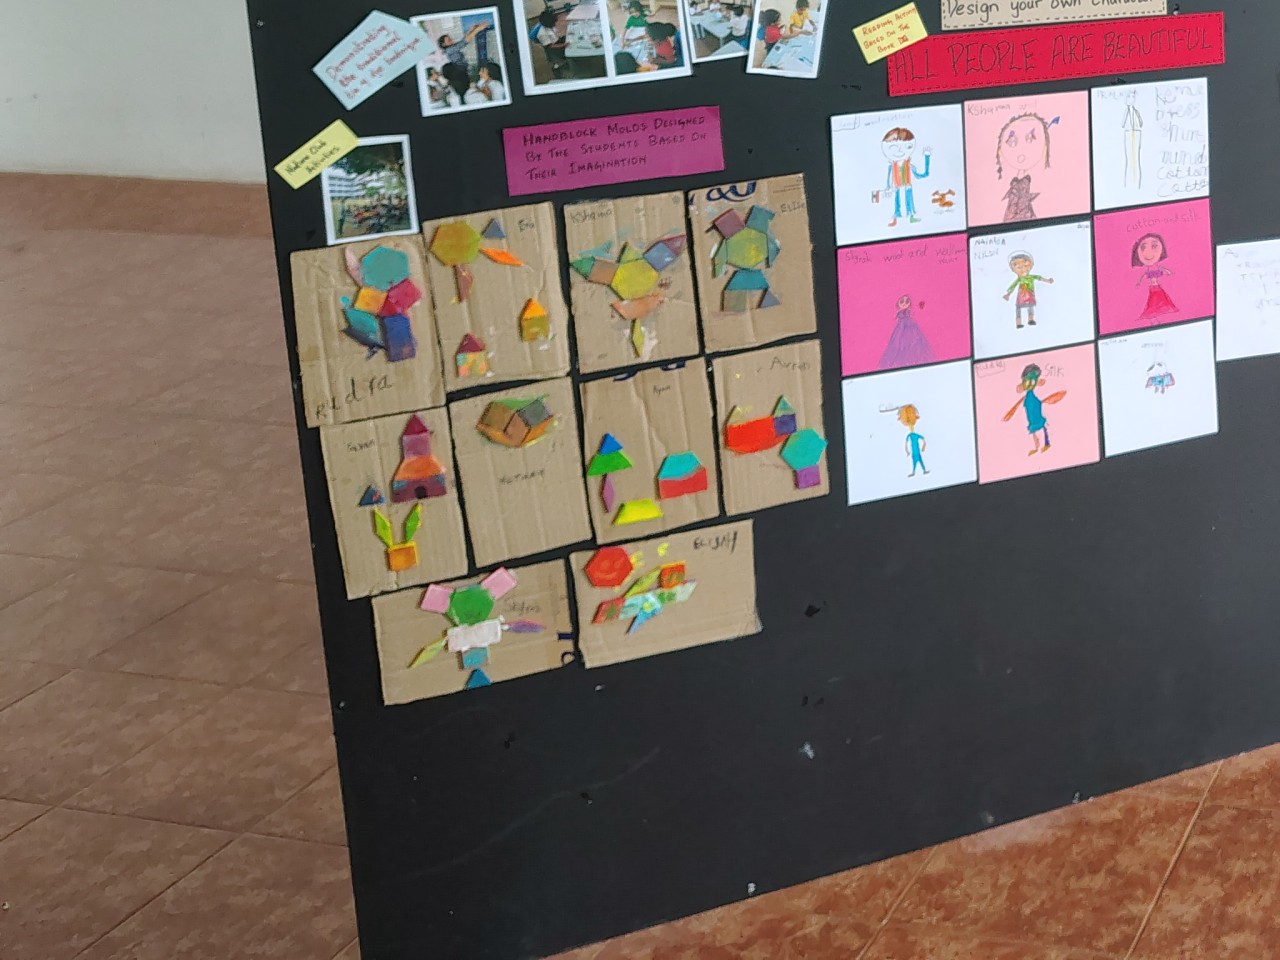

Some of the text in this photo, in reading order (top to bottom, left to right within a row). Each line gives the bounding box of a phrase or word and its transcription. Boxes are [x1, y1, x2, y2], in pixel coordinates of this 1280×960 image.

[948, 38, 1039, 77] PEOPLE
[1051, 32, 1095, 70] ARE
[1104, 26, 1213, 61] BEAUTIFUL
[523, 116, 705, 146] HANDBLOCK MOLDS DESIGNED
[581, 141, 639, 155] STUDENTS
[649, 134, 685, 146] BASED
[526, 155, 647, 181] THEIR IMAGINATION
